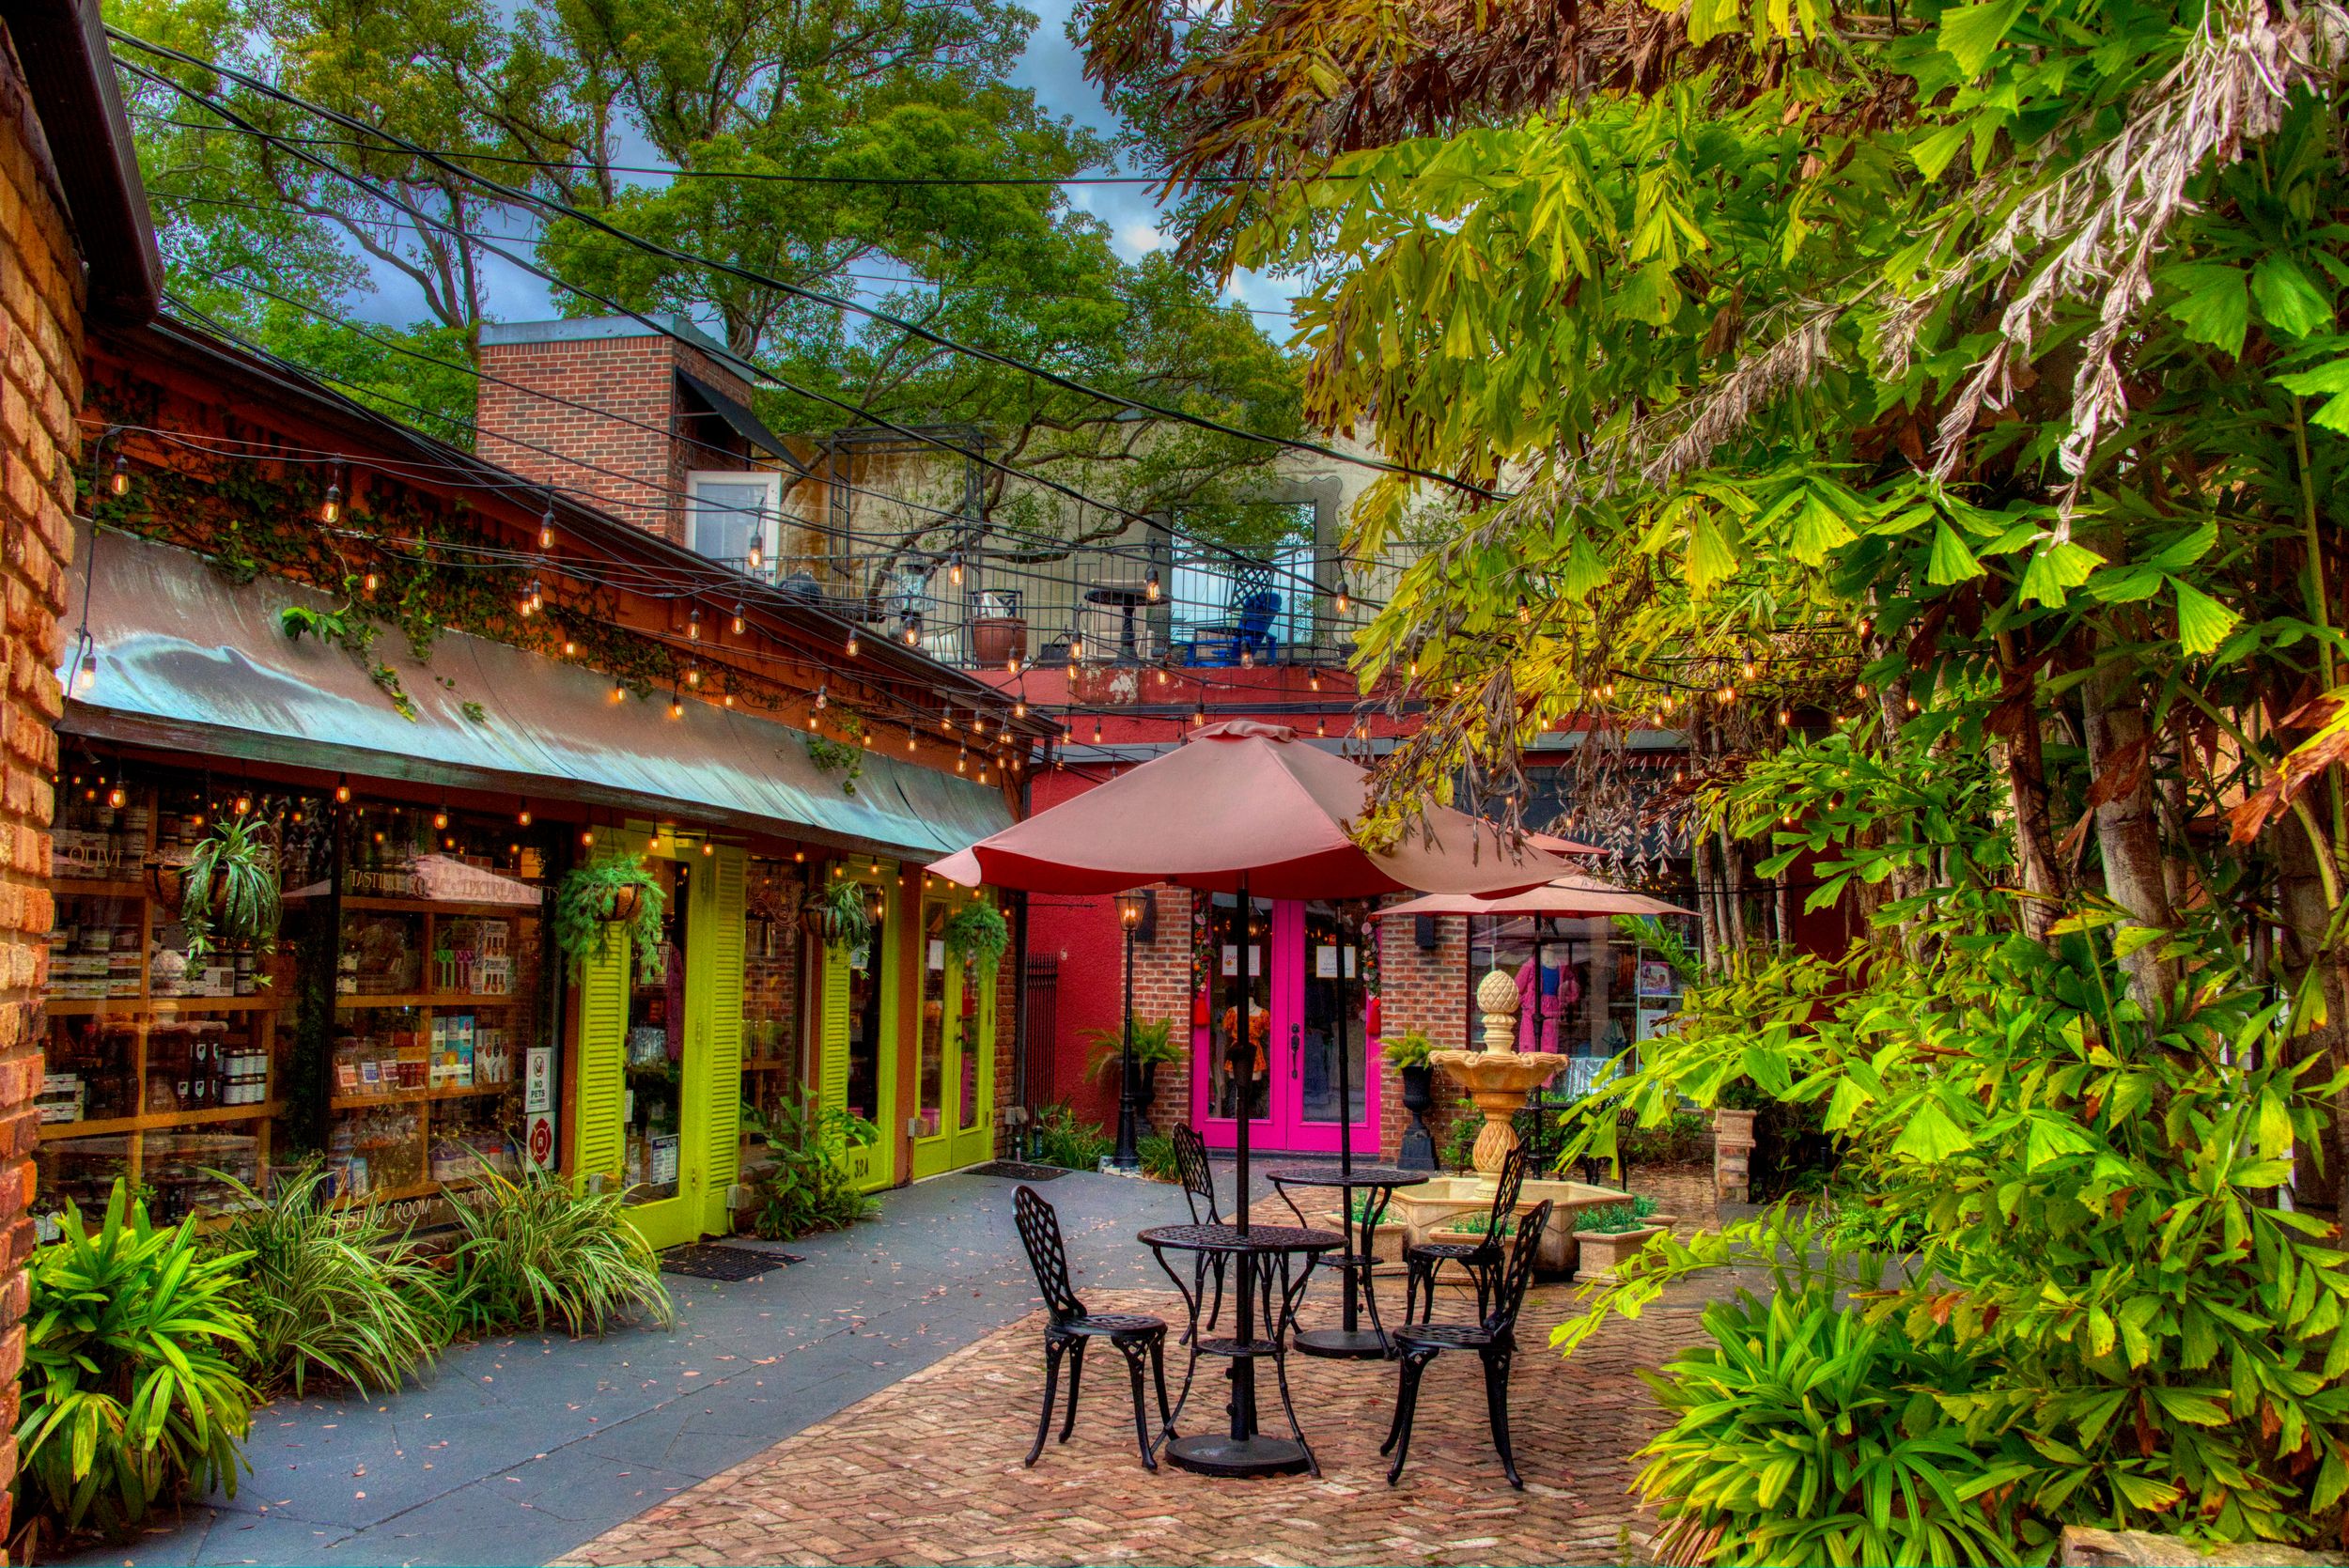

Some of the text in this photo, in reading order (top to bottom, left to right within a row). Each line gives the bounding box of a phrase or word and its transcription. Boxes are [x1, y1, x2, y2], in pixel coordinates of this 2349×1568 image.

[529, 884, 560, 901] GIFTS
[534, 1080, 543, 1089] NO
[531, 1089, 545, 1098] PETS
[537, 1137, 543, 1146] R
[855, 1157, 869, 1179] 324
[394, 1199, 431, 1224] ROOM
